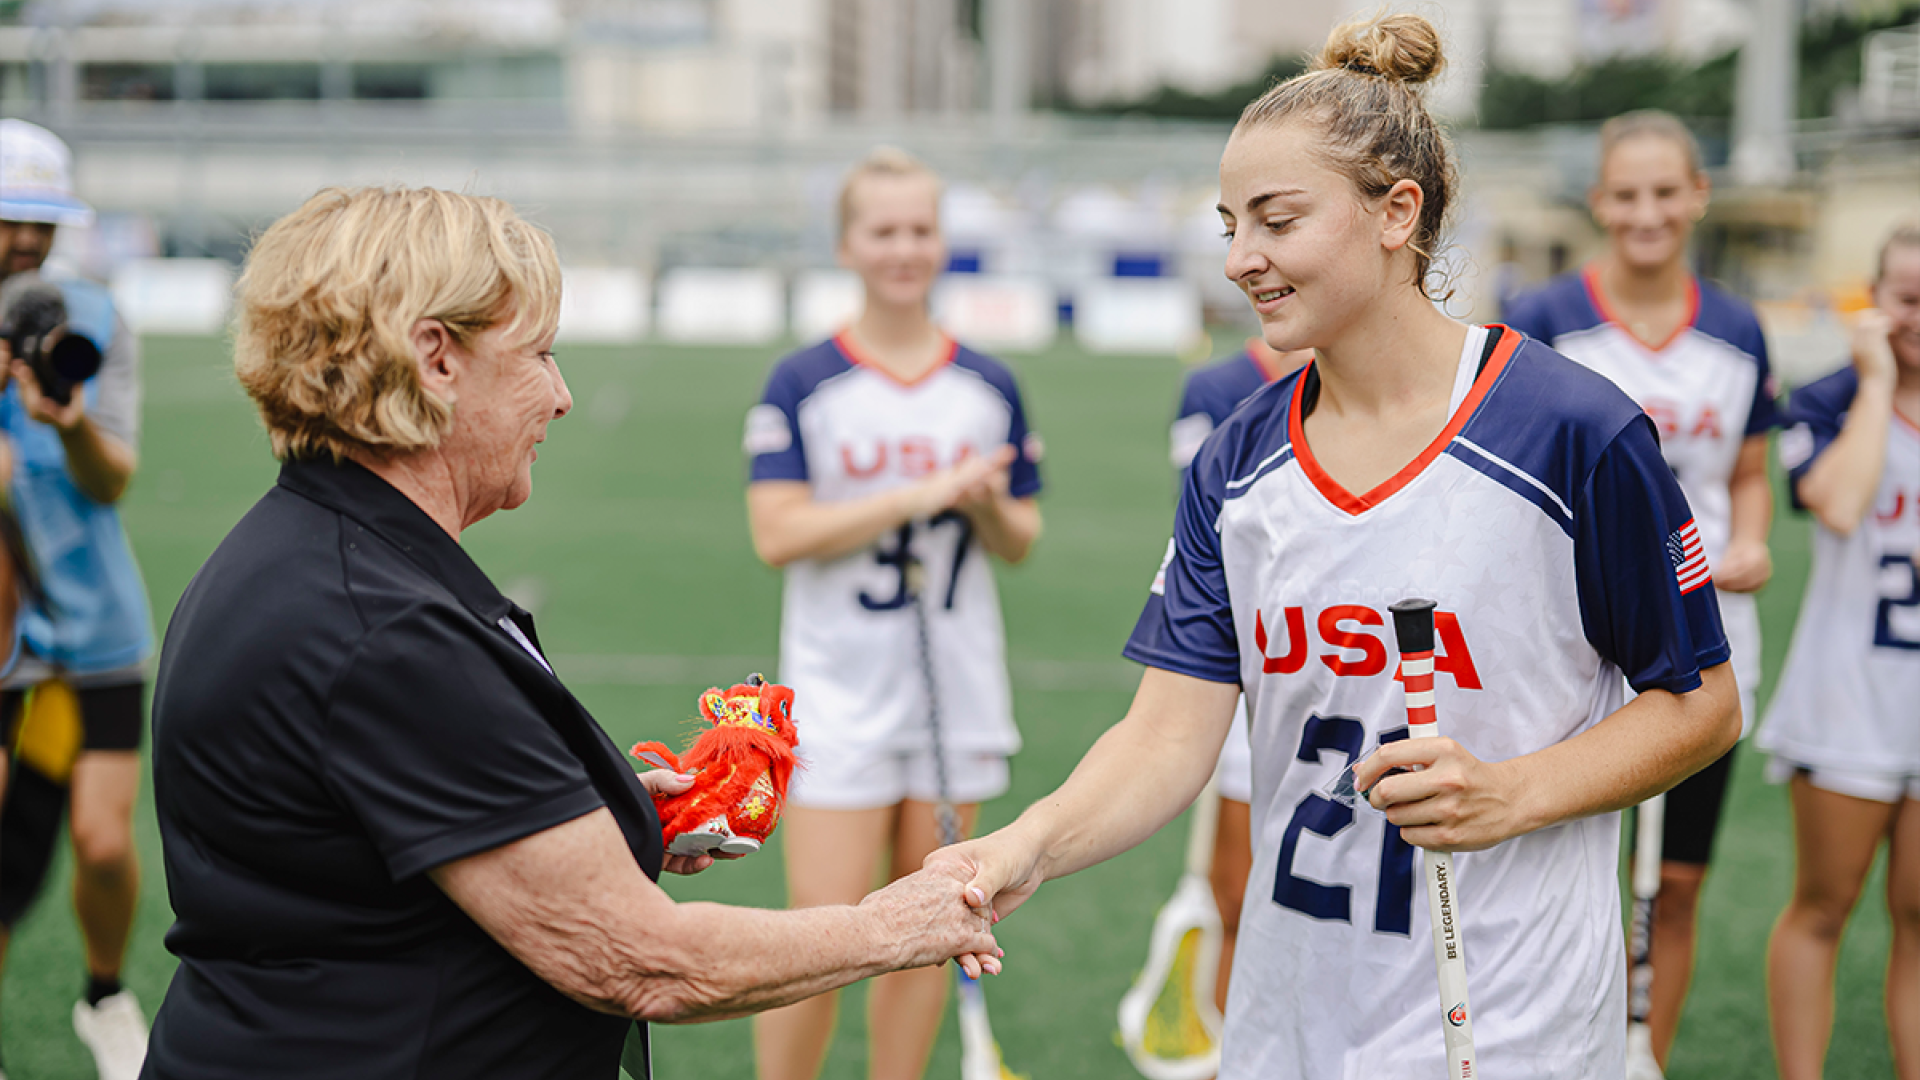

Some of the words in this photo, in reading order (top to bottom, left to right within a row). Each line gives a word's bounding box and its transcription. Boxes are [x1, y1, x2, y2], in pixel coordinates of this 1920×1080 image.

[857, 508, 976, 612] 37
[1254, 603, 1484, 691] USA
[1271, 711, 1417, 940] 21
[1435, 861, 1455, 941] LEGENDARY.
[1446, 941, 1457, 960] BE
